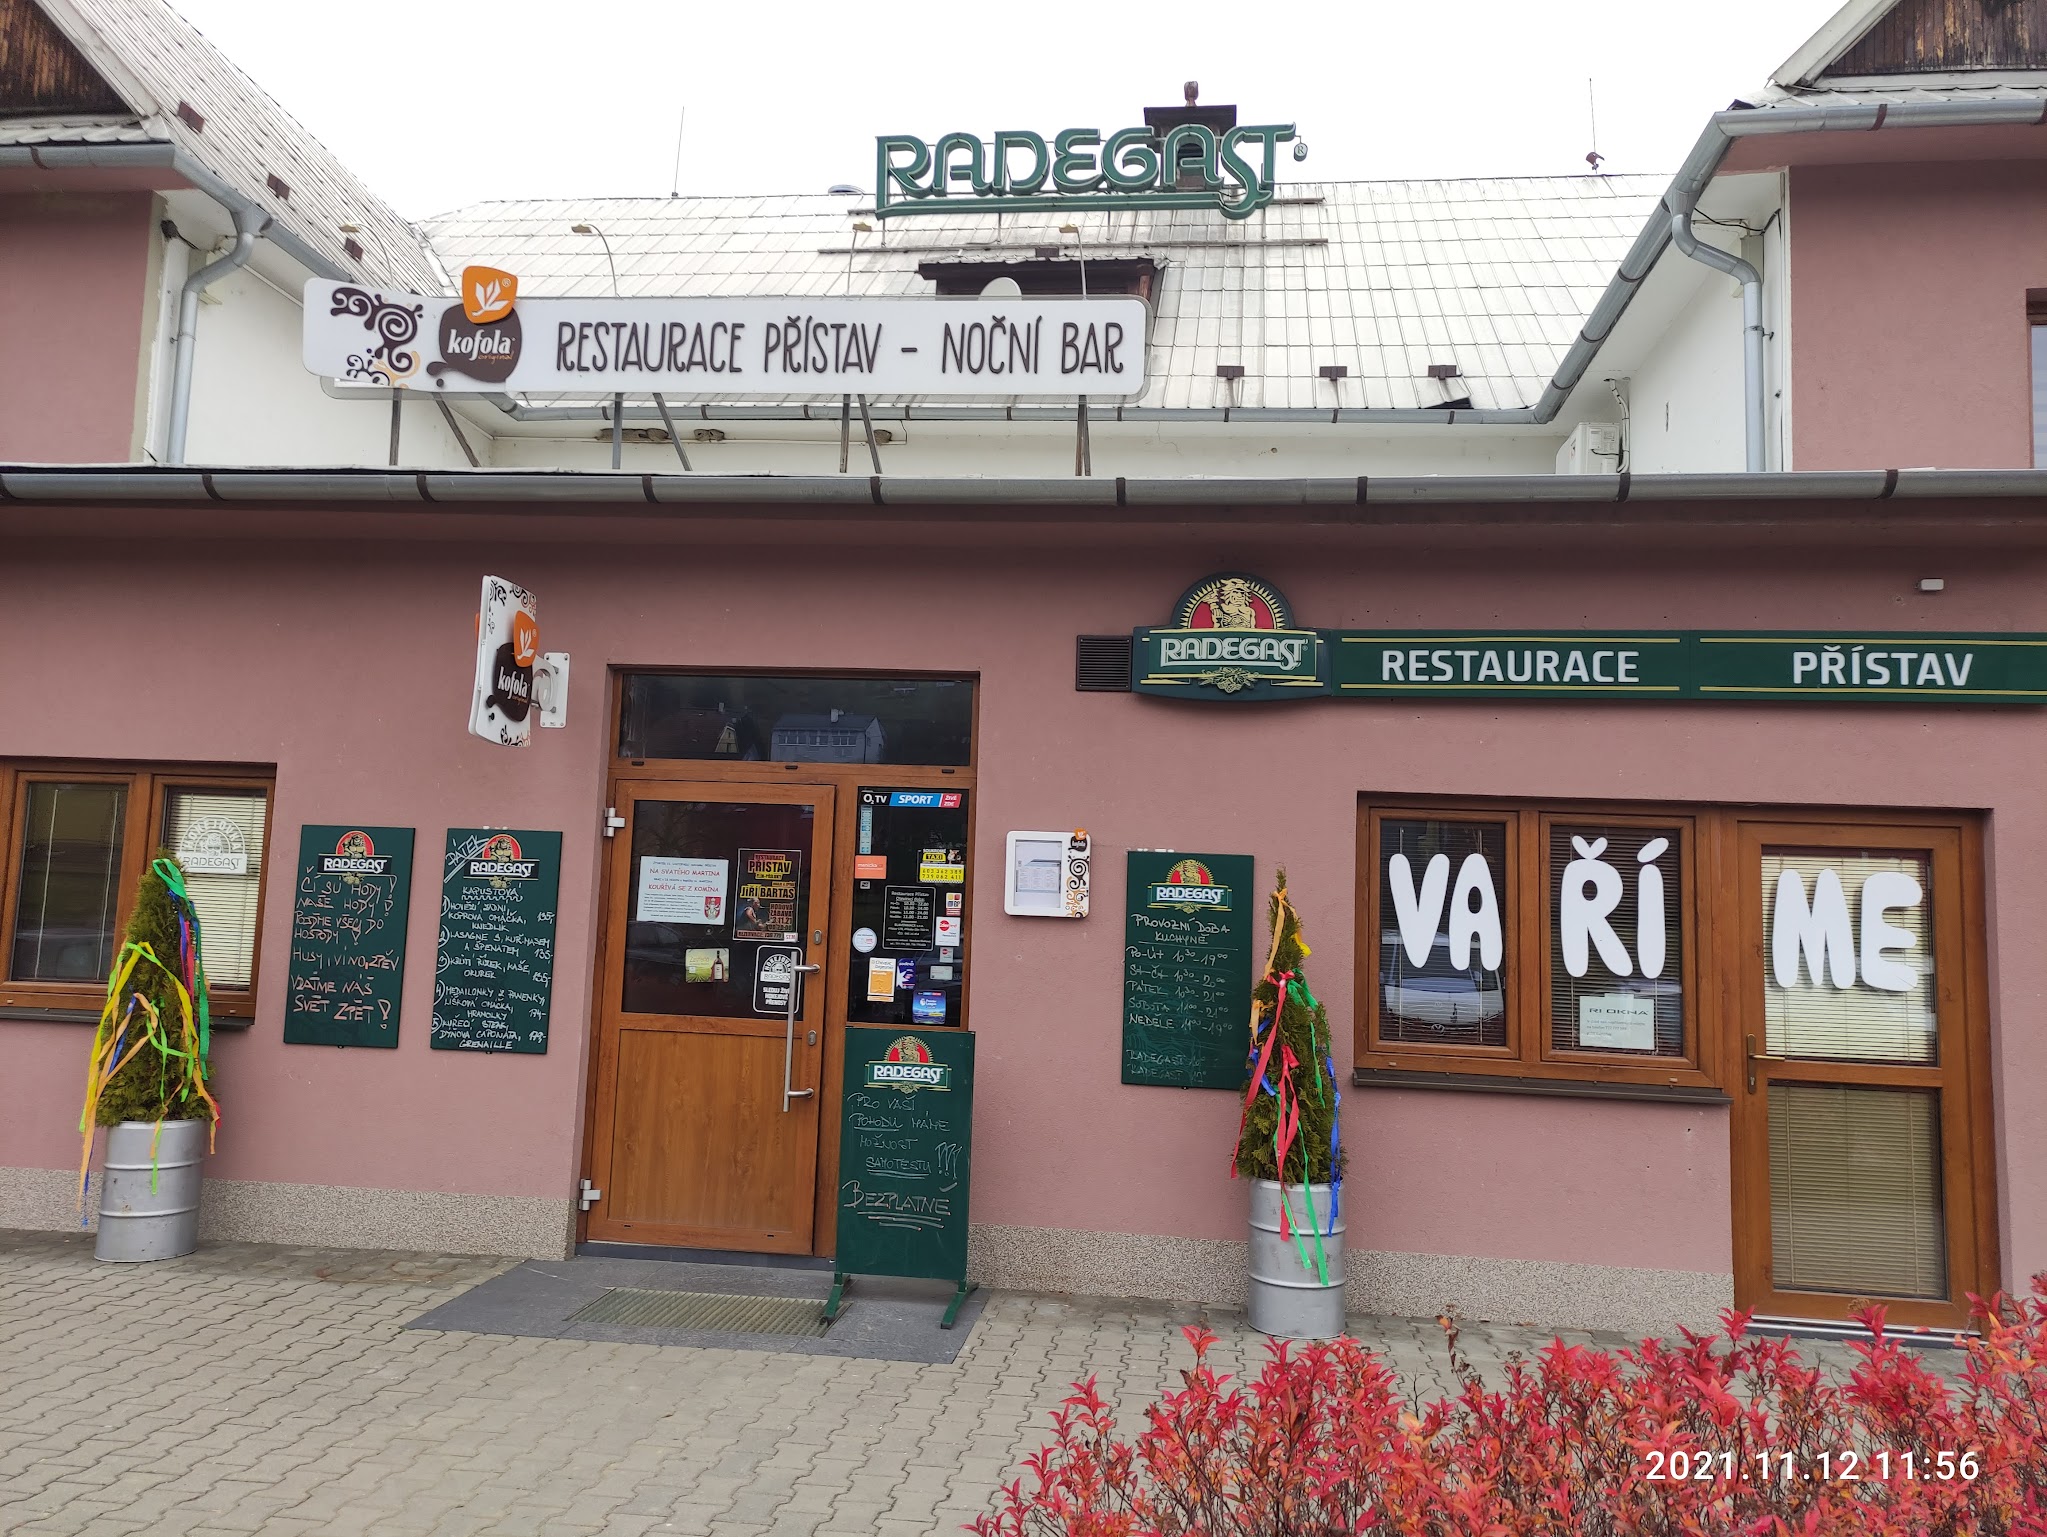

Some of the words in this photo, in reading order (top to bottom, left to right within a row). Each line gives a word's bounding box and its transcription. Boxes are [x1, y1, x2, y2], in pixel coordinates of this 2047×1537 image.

[875, 121, 1296, 220] RADEGAST
[447, 329, 511, 361] kofola
[556, 321, 745, 373] RESTAURACE
[763, 315, 882, 373] PŘÍSTAV
[941, 315, 1042, 374] NOČNÍ
[1061, 322, 1124, 374] BAR
[1160, 637, 1308, 671] RADEGAST
[1381, 649, 1640, 684] RESTAURACE
[1793, 645, 1974, 687] PŘÍSTAV
[498, 666, 529, 699] kofola
[875, 795, 887, 803] TV
[898, 794, 933, 804] SPORT
[323, 858, 387, 873] RADEGAST
[470, 862, 535, 877] RADEGAST
[749, 859, 791, 873] PŘÍSTAV
[1156, 886, 1224, 904] RADEGAST
[365, 918, 384, 934] DO
[1388, 853, 1502, 971] VA
[1560, 835, 1669, 979] ŘÍ
[1772, 869, 1923, 992] ME
[873, 1065, 944, 1083] RADEGAST
